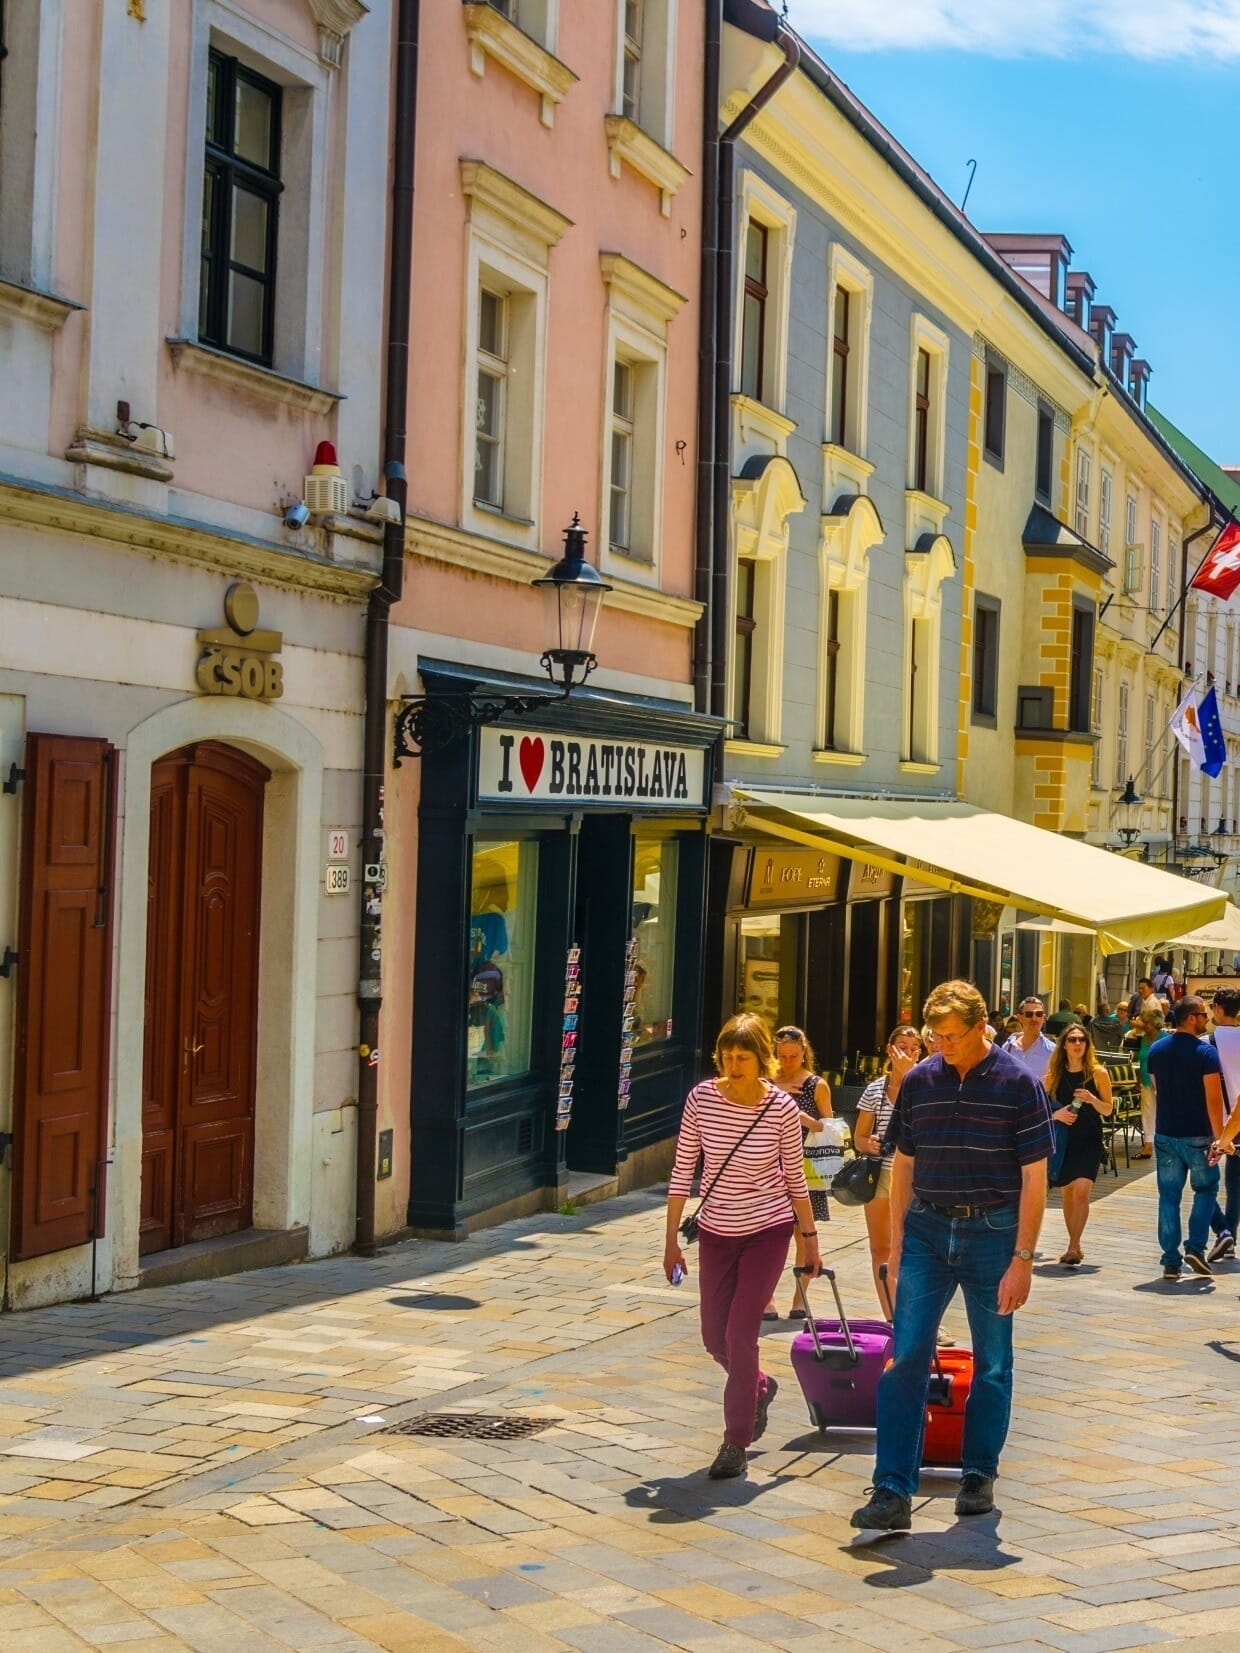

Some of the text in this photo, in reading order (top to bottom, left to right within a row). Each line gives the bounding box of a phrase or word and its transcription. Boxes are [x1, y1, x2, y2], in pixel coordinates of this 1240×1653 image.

[498, 734, 688, 799] I BRATISLAVA
[333, 836, 344, 854] 20
